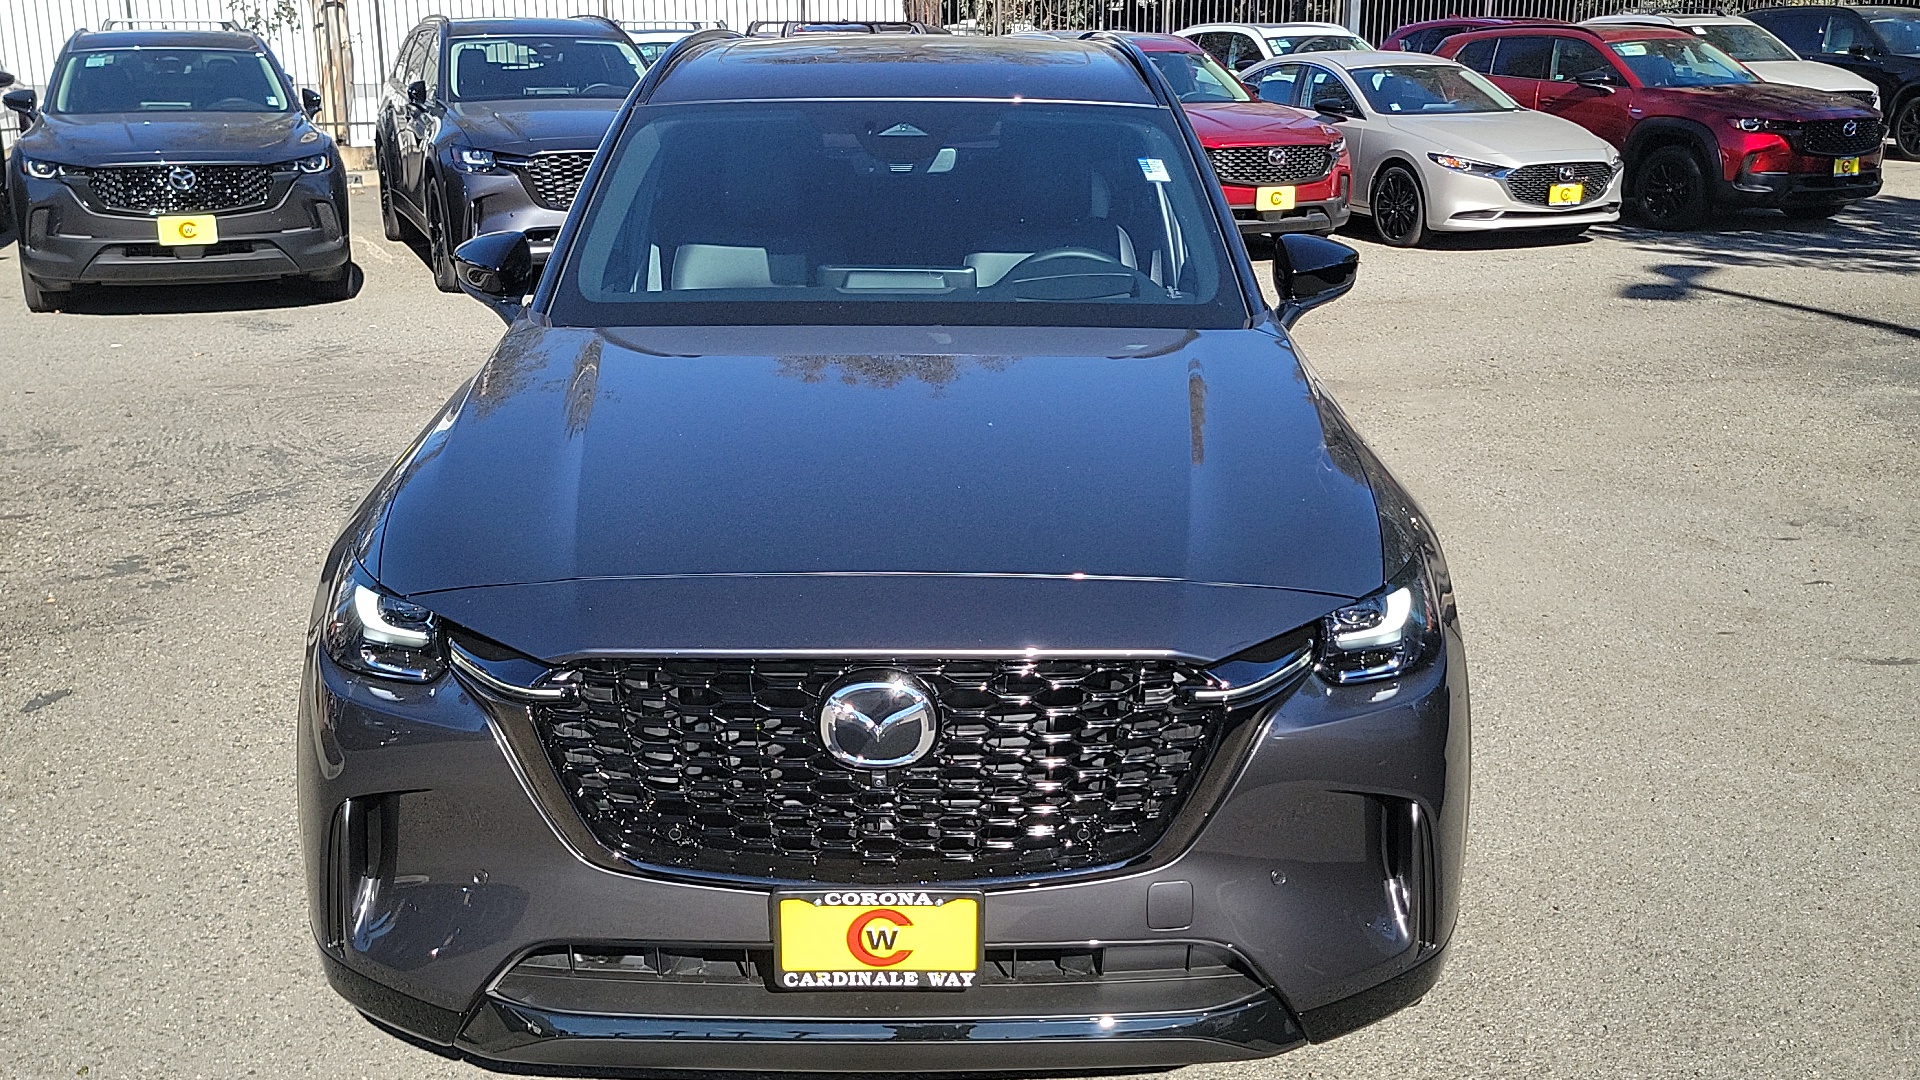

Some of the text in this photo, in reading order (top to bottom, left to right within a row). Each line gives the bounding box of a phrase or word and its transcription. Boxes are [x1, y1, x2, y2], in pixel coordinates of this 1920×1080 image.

[824, 892, 933, 906] CORONA
[846, 908, 914, 967] C
[865, 929, 899, 951] W
[783, 971, 976, 987] CARDINALE WAY
